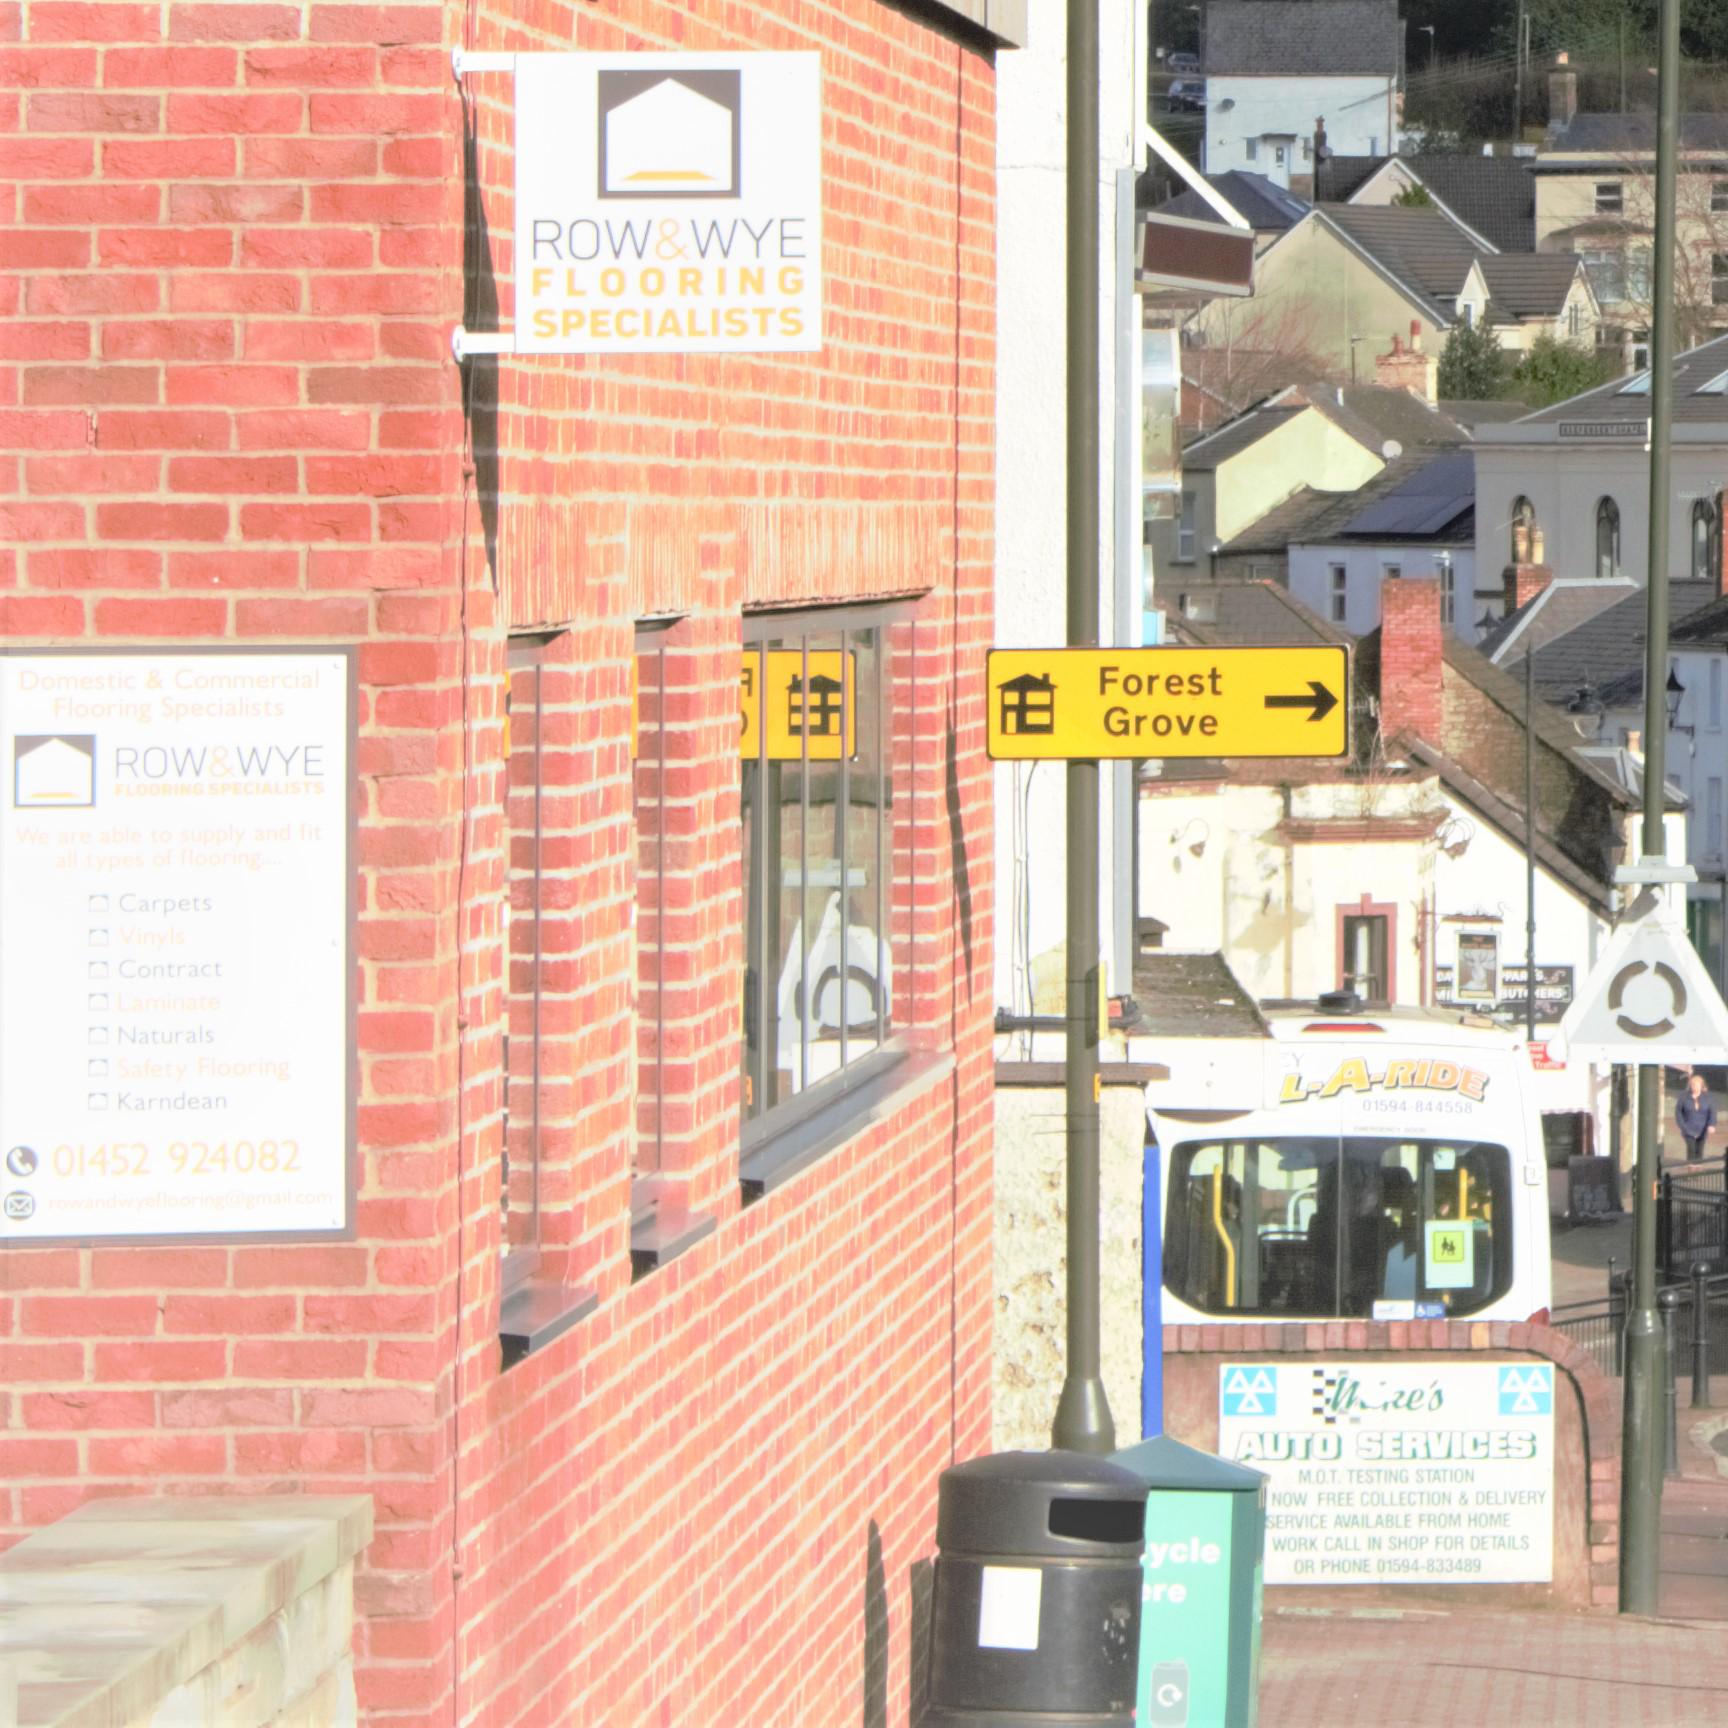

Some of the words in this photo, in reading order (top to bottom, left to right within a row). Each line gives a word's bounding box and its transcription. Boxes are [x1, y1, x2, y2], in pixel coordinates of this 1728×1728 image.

[532, 218, 806, 260] ROW&WYE
[532, 266, 804, 297] FLOORING
[533, 307, 804, 338] SPECIALISTS
[18, 669, 136, 691] Domestic
[144, 670, 163, 689] &
[174, 668, 320, 690] Commercial
[1099, 665, 1223, 697] Forest
[53, 696, 152, 722] Flooring
[160, 696, 285, 721] Specialists
[1103, 706, 1219, 737] Grove
[115, 744, 325, 779] ROW&WYE
[114, 783, 204, 799] FLOORING
[208, 780, 326, 797] SPECIALISTS
[15, 826, 49, 845] We
[58, 828, 92, 845] are
[99, 824, 142, 845] able
[151, 826, 174, 844] to
[180, 823, 247, 850] supply
[255, 821, 292, 842] and
[300, 820, 323, 841] fit
[55, 851, 78, 870] all
[87, 851, 145, 873] types
[152, 849, 173, 867] of
[118, 892, 214, 917] Carpets
[118, 925, 186, 951] Vinyls
[118, 959, 223, 980] Contract
[116, 993, 221, 1014] Laminate
[117, 1024, 216, 1046] Naturals
[116, 1058, 188, 1083] Safety
[196, 1057, 291, 1081] Flooring
[117, 1091, 228, 1112] Karndean
[51, 1142, 151, 1178] 01452
[167, 1138, 302, 1176] 924082
[1235, 1430, 1343, 1462] AUTO
[1355, 1429, 1538, 1461] SERVICES
[1298, 1469, 1342, 1485] M.O.T.
[1348, 1468, 1410, 1485] TESTING
[1415, 1468, 1475, 1484] STATION
[1272, 1491, 1308, 1507] NOW
[1317, 1491, 1354, 1507] FREE
[1360, 1490, 1452, 1507] COLLECTION
[1458, 1490, 1470, 1506] &
[1475, 1489, 1547, 1506] DELIVERY
[1266, 1514, 1328, 1530] SERVICE
[1333, 1513, 1413, 1530] AVAILABLE
[1418, 1512, 1462, 1529] FROM
[1468, 1512, 1511, 1528] HOME
[1272, 1536, 1319, 1553] WORK
[1324, 1536, 1361, 1552] CALL
[1368, 1536, 1383, 1552] IN
[1388, 1536, 1430, 1552] SHOP
[1434, 1535, 1464, 1551] FOR
[1469, 1535, 1530, 1551] DETAILS
[1294, 1558, 1315, 1575] OR
[1320, 1558, 1372, 1575] PHONE
[1376, 1558, 1482, 1574] 01594-833489
